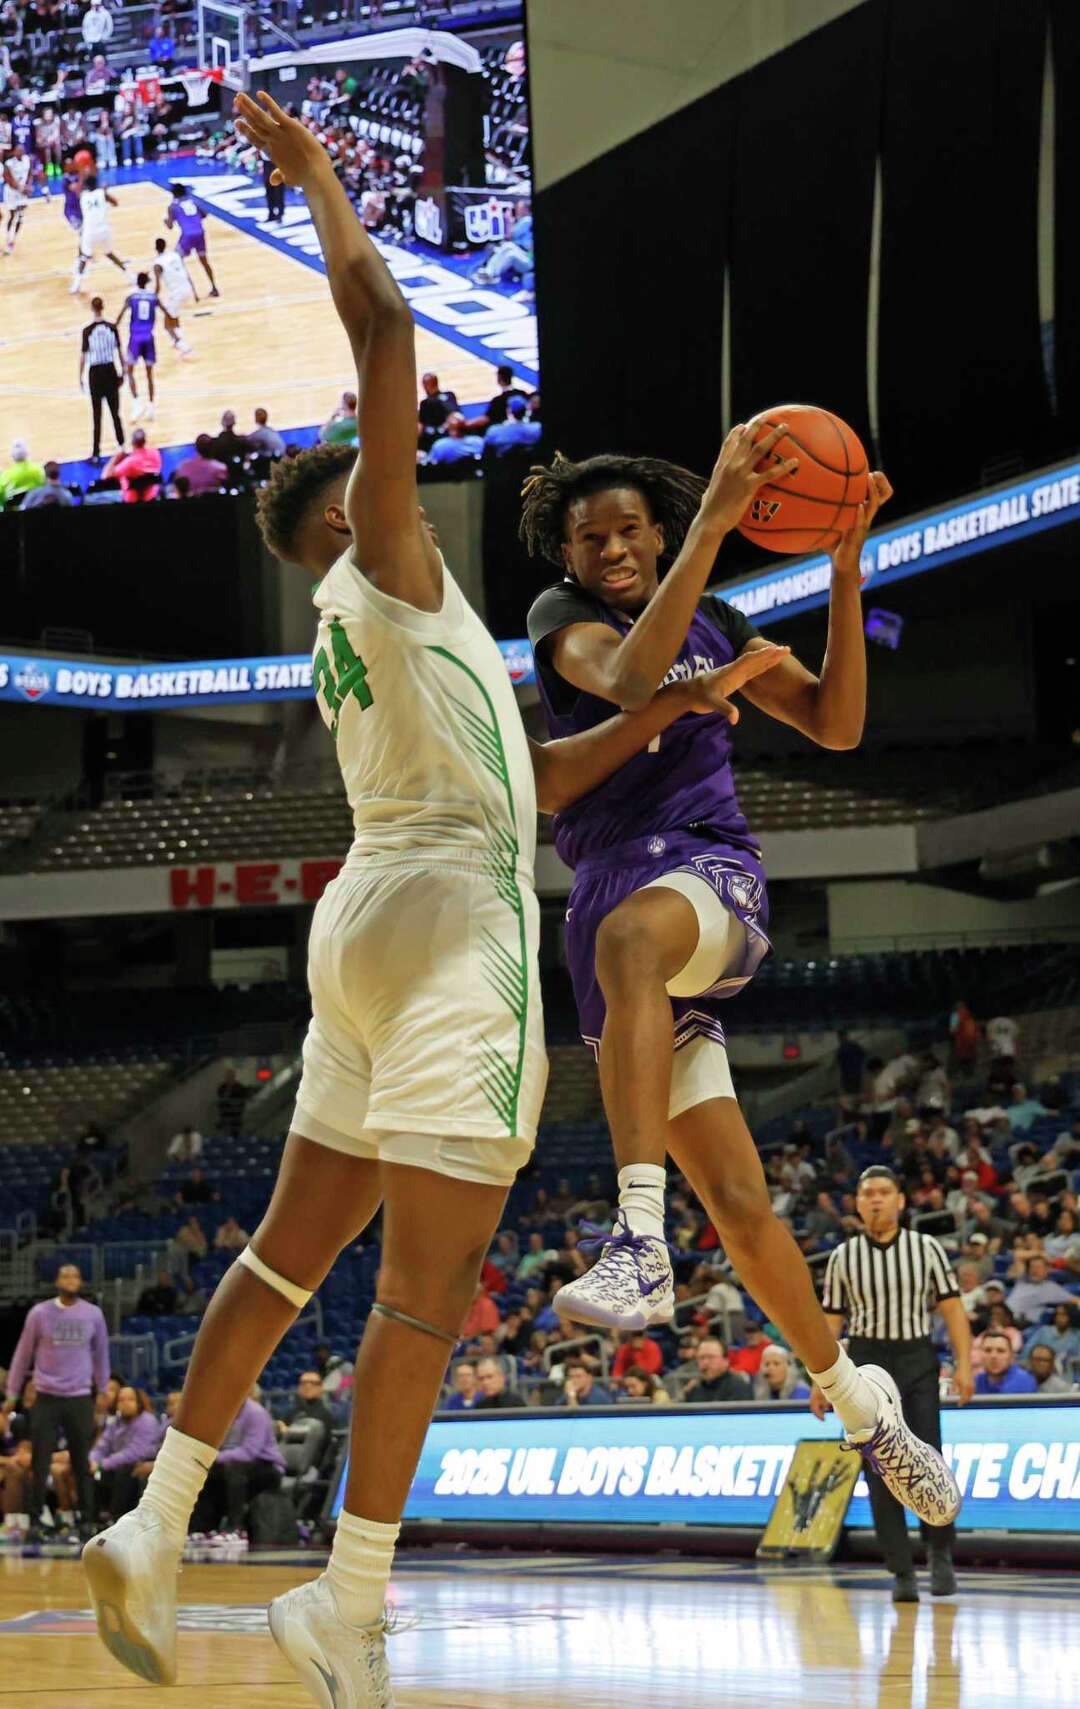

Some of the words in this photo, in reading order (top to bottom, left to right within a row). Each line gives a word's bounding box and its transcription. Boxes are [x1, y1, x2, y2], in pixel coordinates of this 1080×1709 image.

[877, 529, 922, 571] BOYS
[923, 494, 1030, 555] BASKETBALL
[1032, 474, 1080, 518] STATE
[56, 669, 112, 697] BOYS
[115, 667, 251, 698] BASKETBALL
[254, 663, 312, 690] STATE
[434, 1448, 512, 1496] 2025
[507, 1448, 557, 1496] UIL
[557, 1446, 649, 1497] BOYS
[643, 1444, 796, 1497] BASKET
